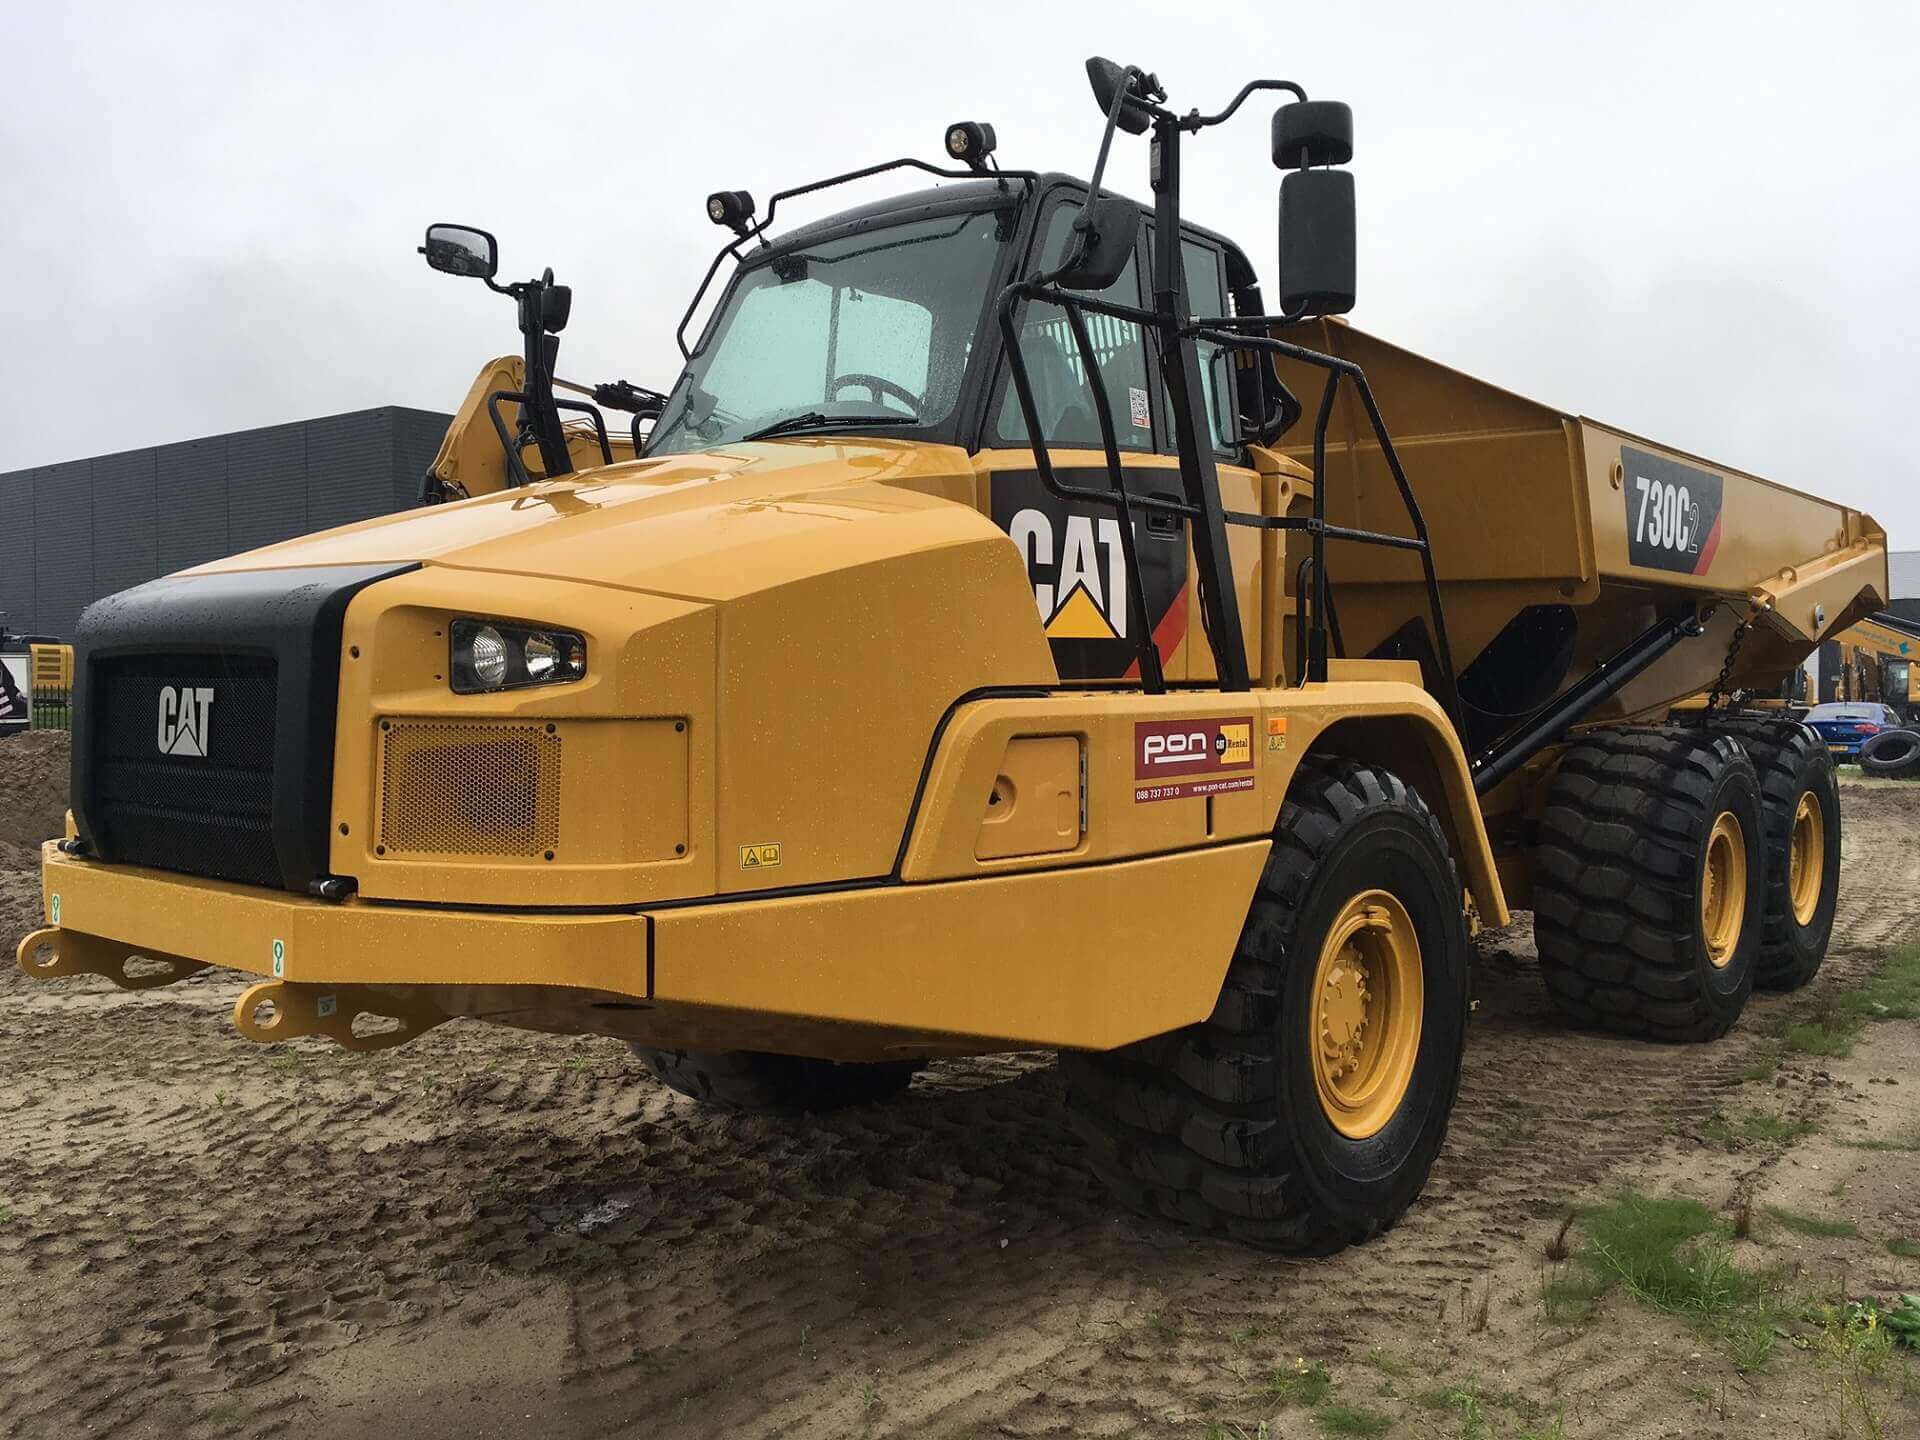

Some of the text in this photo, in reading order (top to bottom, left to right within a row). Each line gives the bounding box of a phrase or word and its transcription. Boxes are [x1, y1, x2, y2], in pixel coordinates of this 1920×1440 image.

[1009, 508, 1136, 639] CAT
[158, 686, 215, 757] CAT
[1144, 732, 1207, 765] pon
[1228, 738, 1248, 749] Rental
[1136, 790, 1149, 800] 088
[1150, 789, 1161, 799] 737
[1163, 787, 1174, 797] 737
